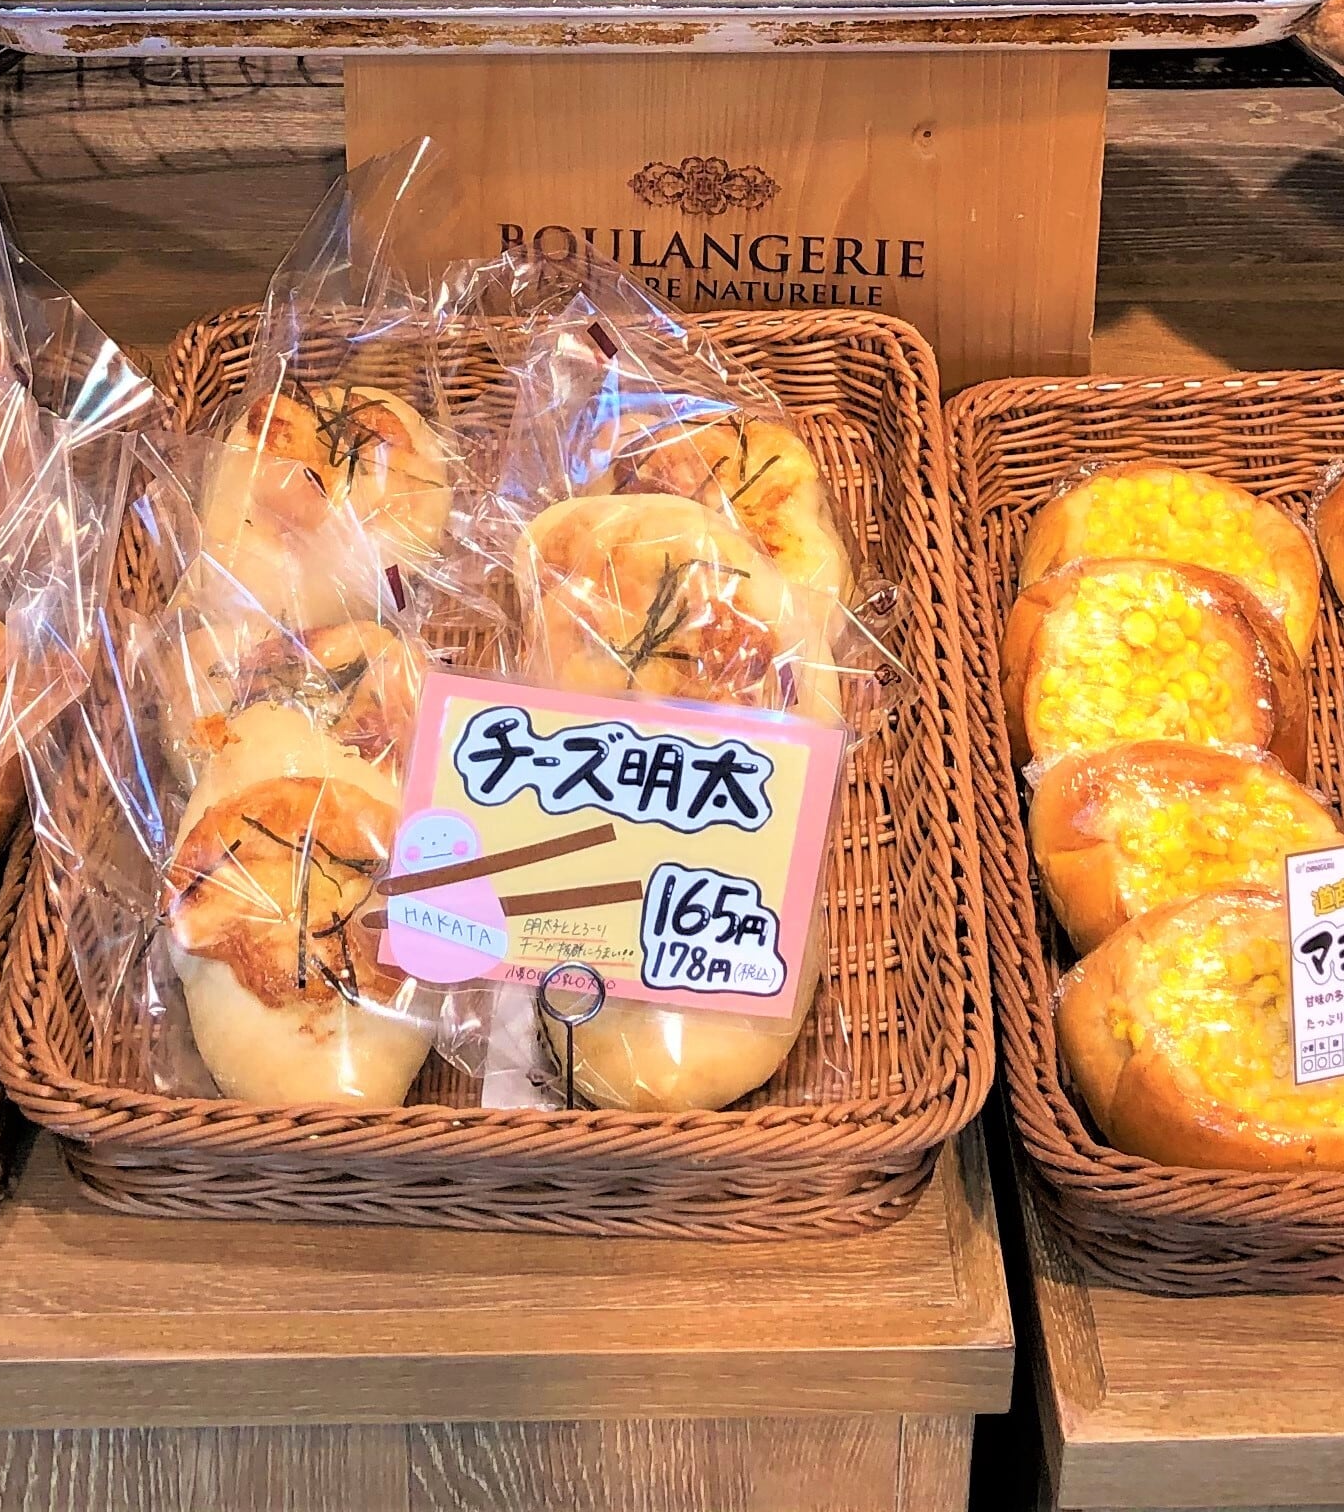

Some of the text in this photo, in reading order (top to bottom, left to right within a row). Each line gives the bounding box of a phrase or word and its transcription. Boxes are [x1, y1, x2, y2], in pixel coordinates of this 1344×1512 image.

[694, 277, 883, 307] NATURELLE
[459, 717, 759, 820] チーズ明太
[404, 906, 492, 947] HAKATA
[653, 874, 769, 947] 165円
[651, 941, 777, 988] 178円(税込)
